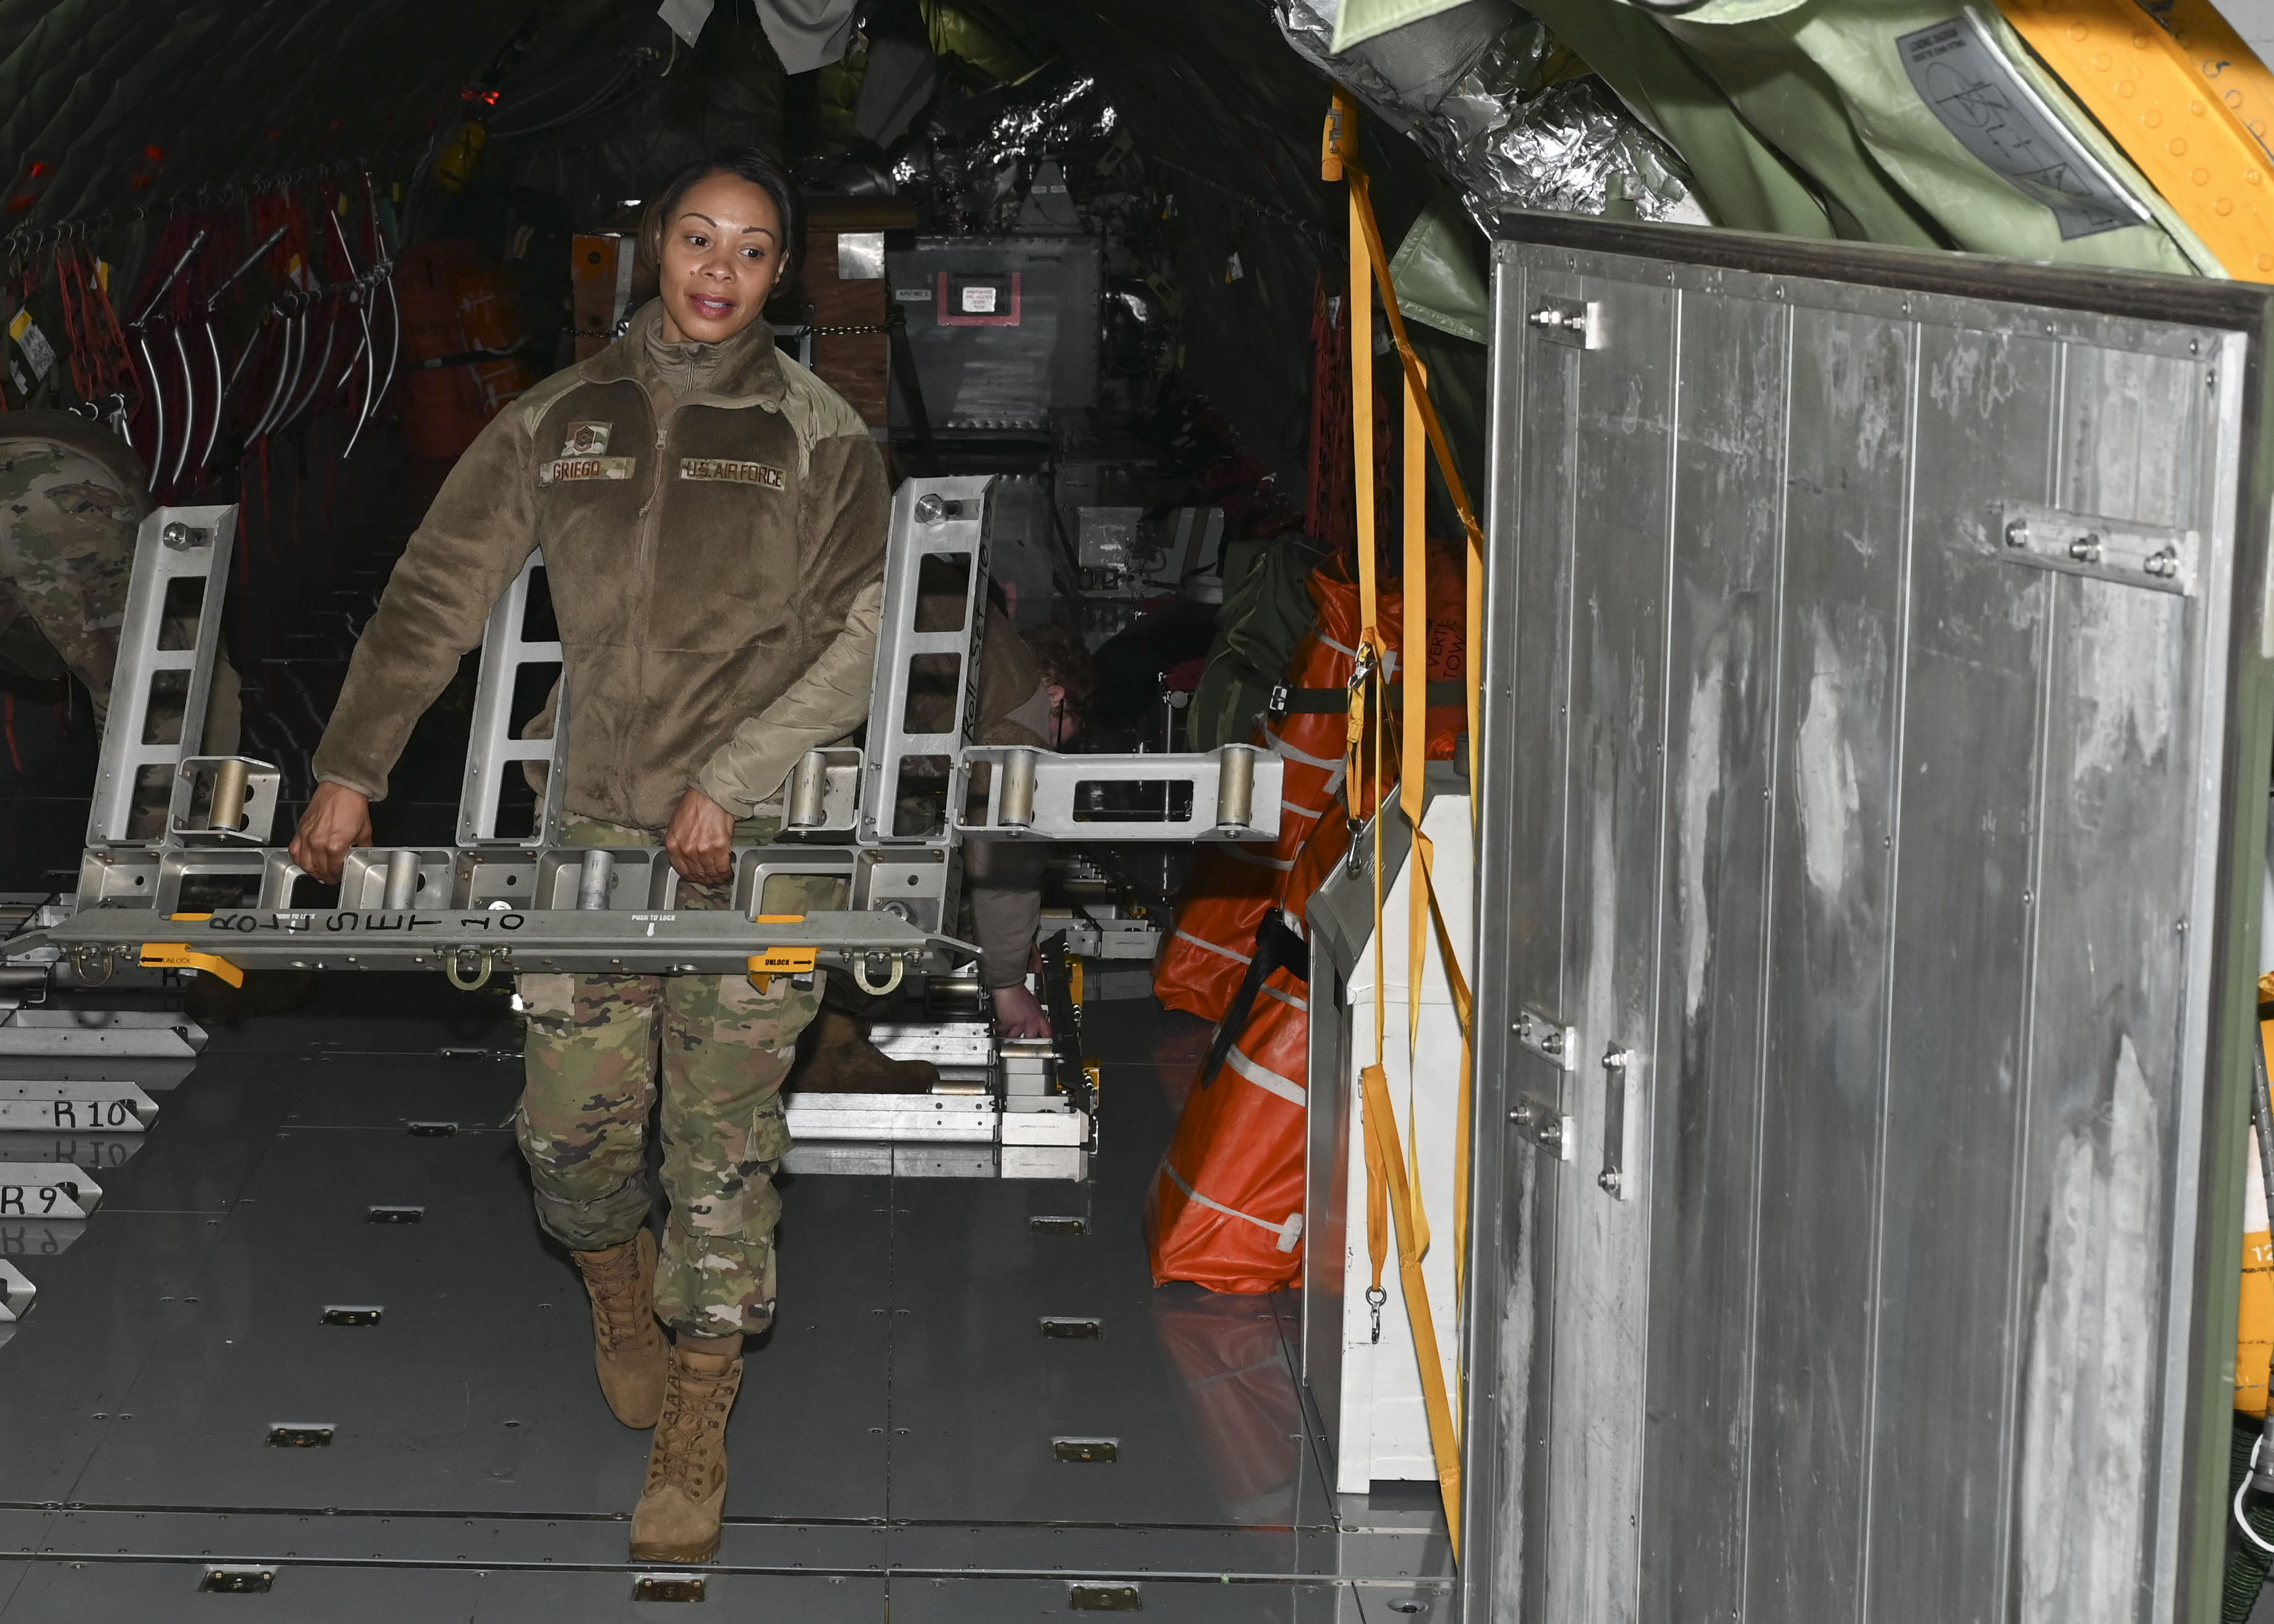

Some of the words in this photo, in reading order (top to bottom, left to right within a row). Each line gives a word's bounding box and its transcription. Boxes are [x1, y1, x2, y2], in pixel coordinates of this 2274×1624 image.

[553, 461, 601, 480] GRIEGO
[687, 461, 711, 479] U.S.
[713, 463, 738, 481] AIR
[740, 464, 783, 487] FORCE
[326, 912, 442, 931] SET
[460, 914, 525, 930] 10
[54, 1101, 75, 1128] R
[88, 1101, 126, 1127] 10
[1, 1186, 25, 1215] R
[39, 1187, 58, 1214] 9
